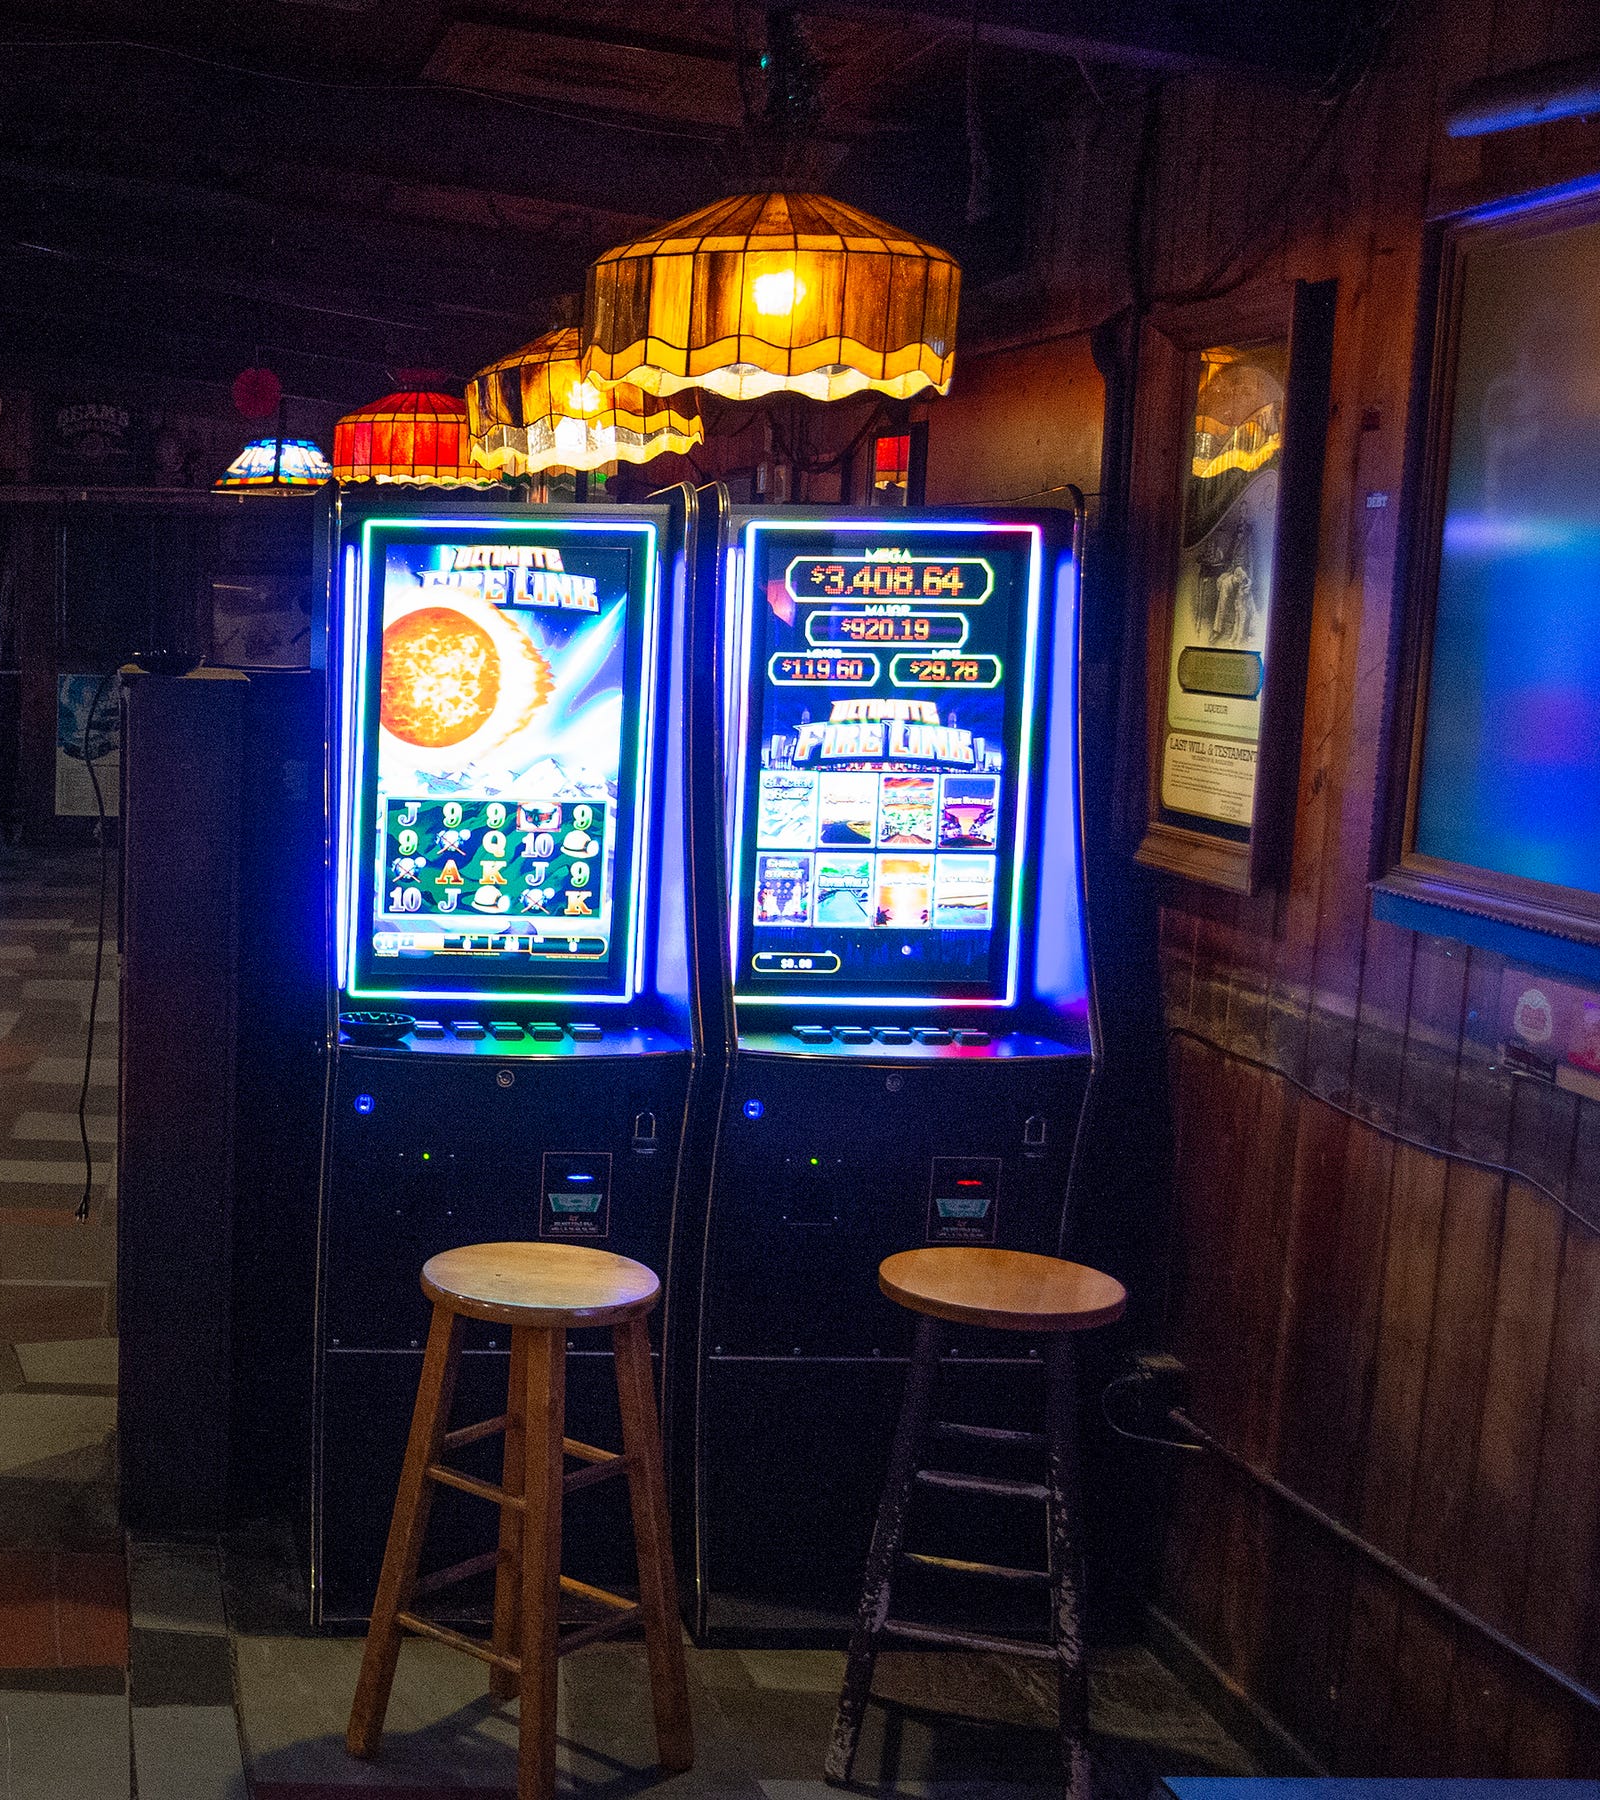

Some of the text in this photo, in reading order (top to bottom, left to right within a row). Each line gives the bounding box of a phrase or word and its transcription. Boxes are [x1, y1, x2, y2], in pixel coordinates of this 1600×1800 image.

[455, 545, 565, 572] ULTIMATE
[865, 548, 912, 563] MEGA
[506, 567, 599, 612] LINK
[811, 565, 964, 596] $3,408.64
[865, 605, 911, 617] MAJOR
[841, 618, 929, 641] $920.19
[782, 658, 979, 682] $119.60 $29.78
[830, 699, 941, 726] ULTIMATE
[793, 719, 976, 765] FIRE LINK
[1169, 738, 1188, 752] LAST
[1188, 740, 1207, 755] WILL
[398, 802, 593, 830] J 9 9 9
[398, 829, 554, 857] 9 Q 10
[435, 859, 590, 887] A K J 9
[389, 887, 592, 914] 10 J K
